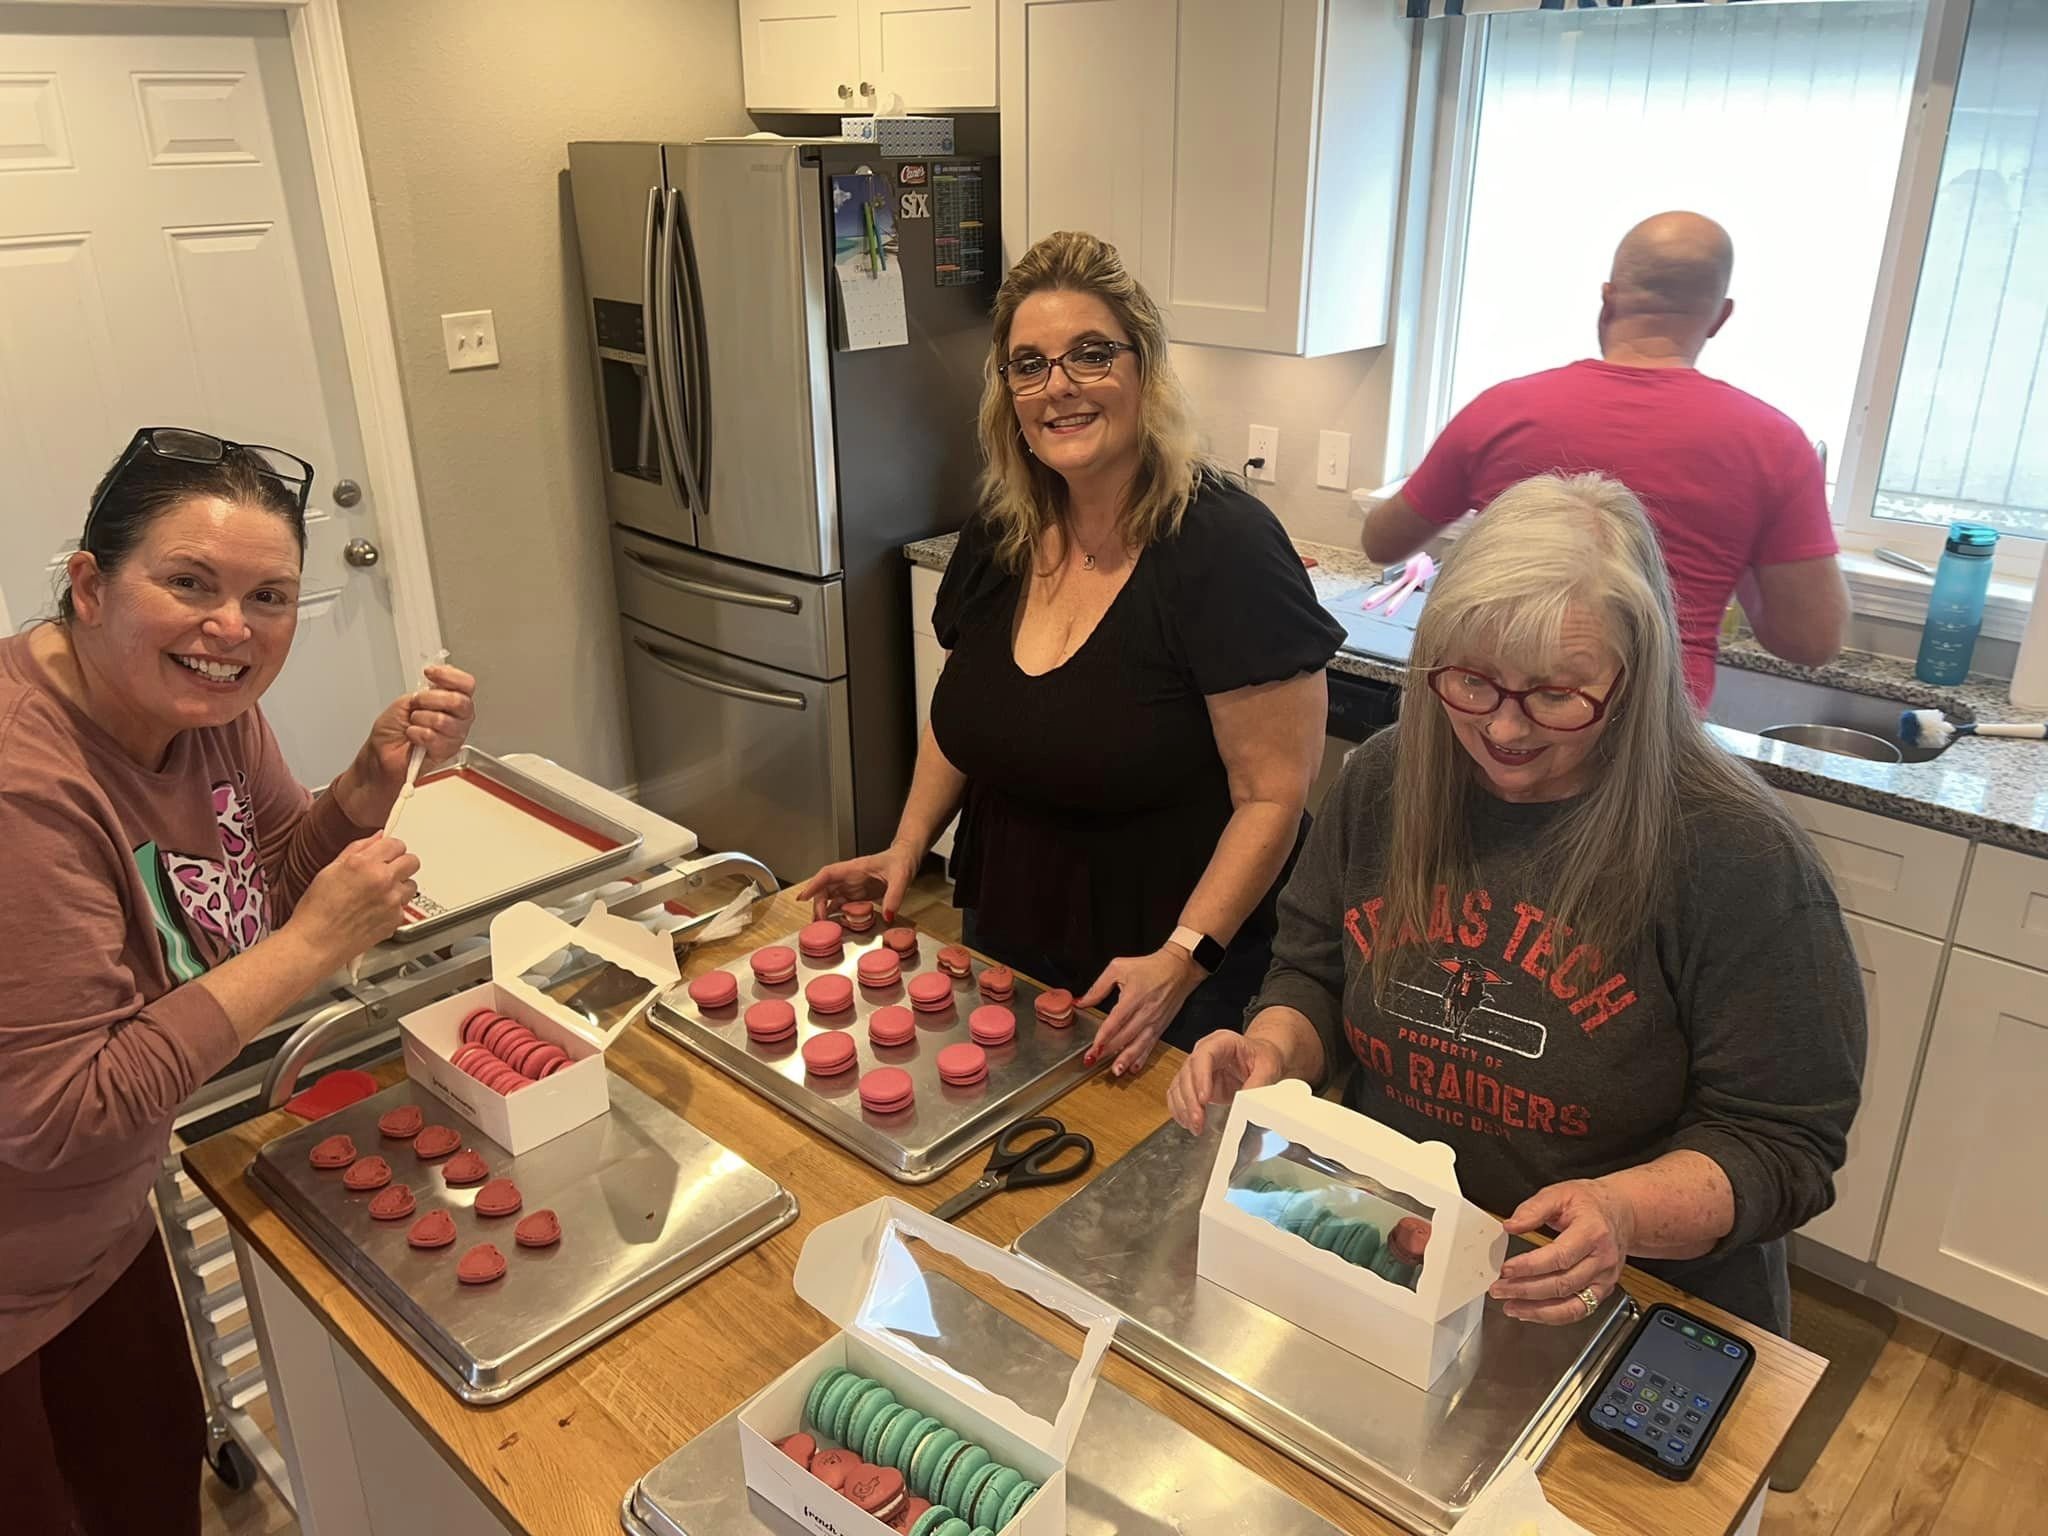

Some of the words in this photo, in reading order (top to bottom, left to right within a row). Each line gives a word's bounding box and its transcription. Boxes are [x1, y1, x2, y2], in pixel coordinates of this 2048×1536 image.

[901, 192, 930, 218] SIX
[1503, 901, 1638, 1036] TECH
[1398, 1027, 1480, 1062] PROPERTY
[1486, 1055, 1504, 1068] OF
[1385, 1084, 1464, 1127] ATHLETIC
[1408, 1052, 1591, 1136] RAIDERS
